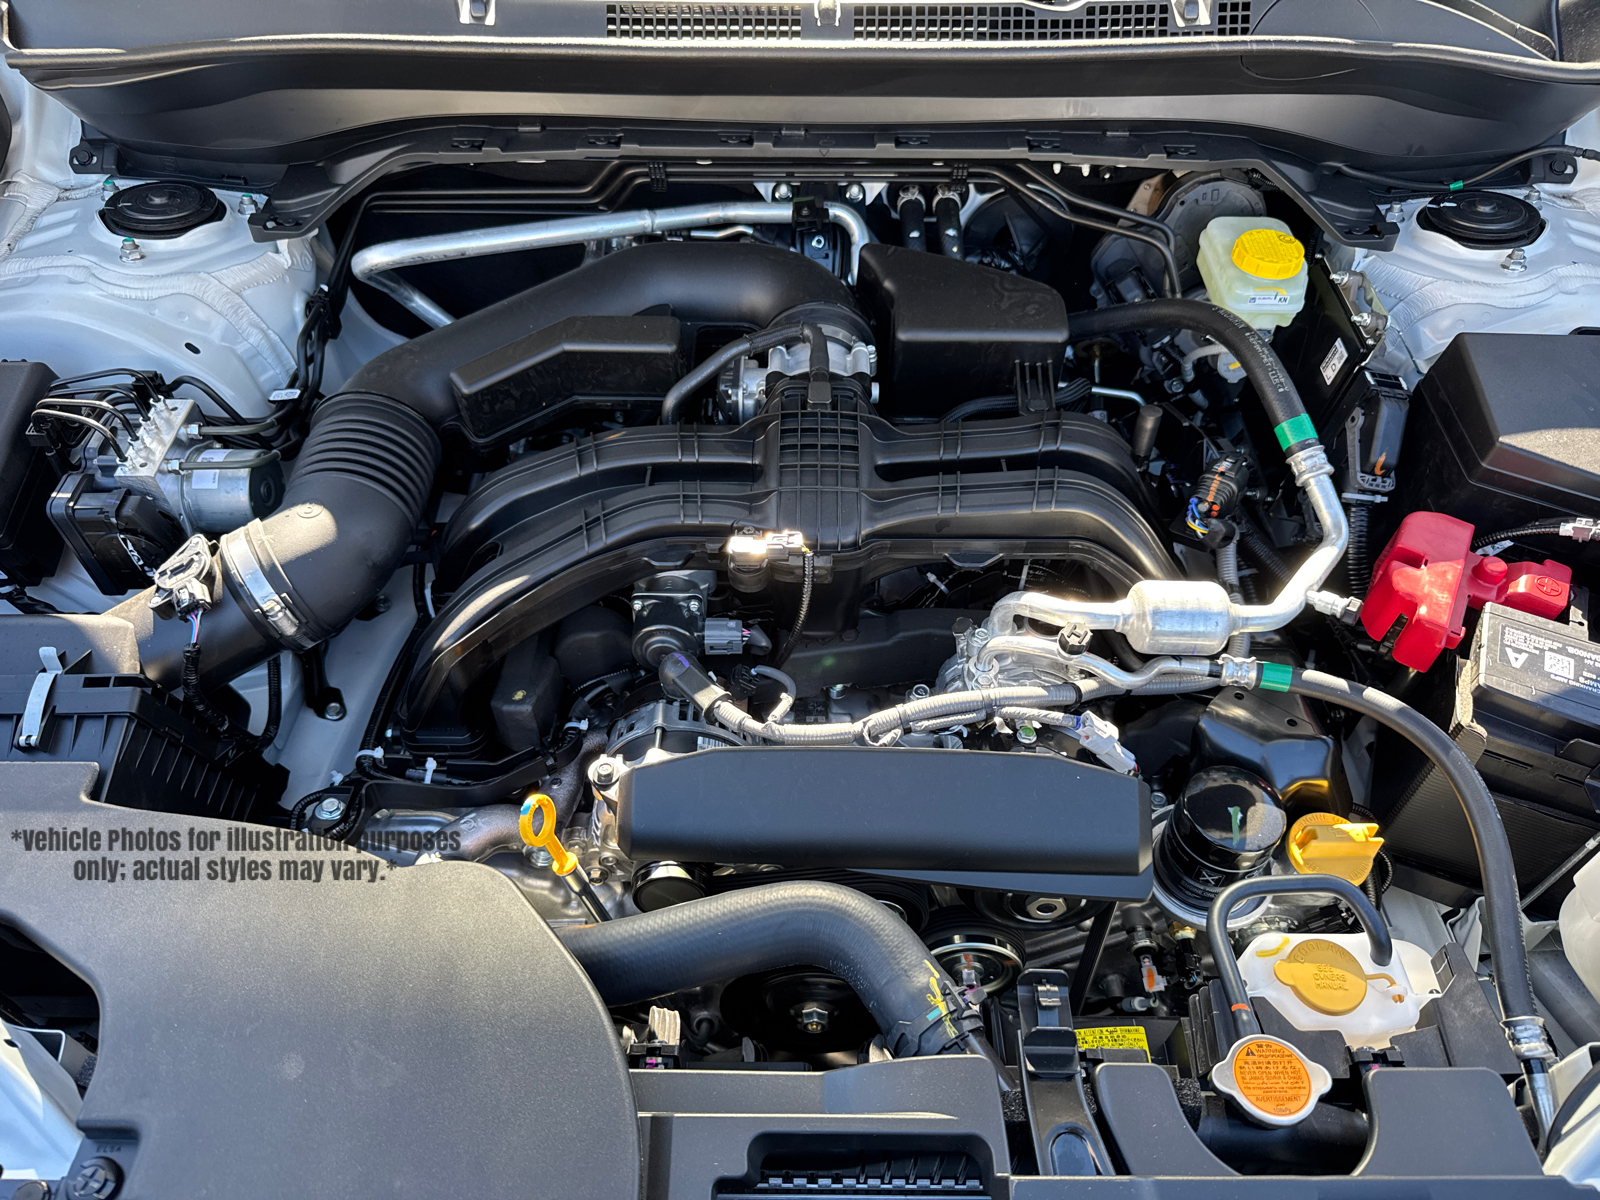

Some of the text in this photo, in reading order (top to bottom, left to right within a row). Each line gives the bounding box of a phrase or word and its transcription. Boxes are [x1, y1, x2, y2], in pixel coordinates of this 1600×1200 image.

[1293, 940, 1355, 964] COOLANT
[1316, 963, 1334, 973] SEE
[1313, 972, 1347, 982] OWNERS
[1314, 980, 1348, 991] MANUAL
